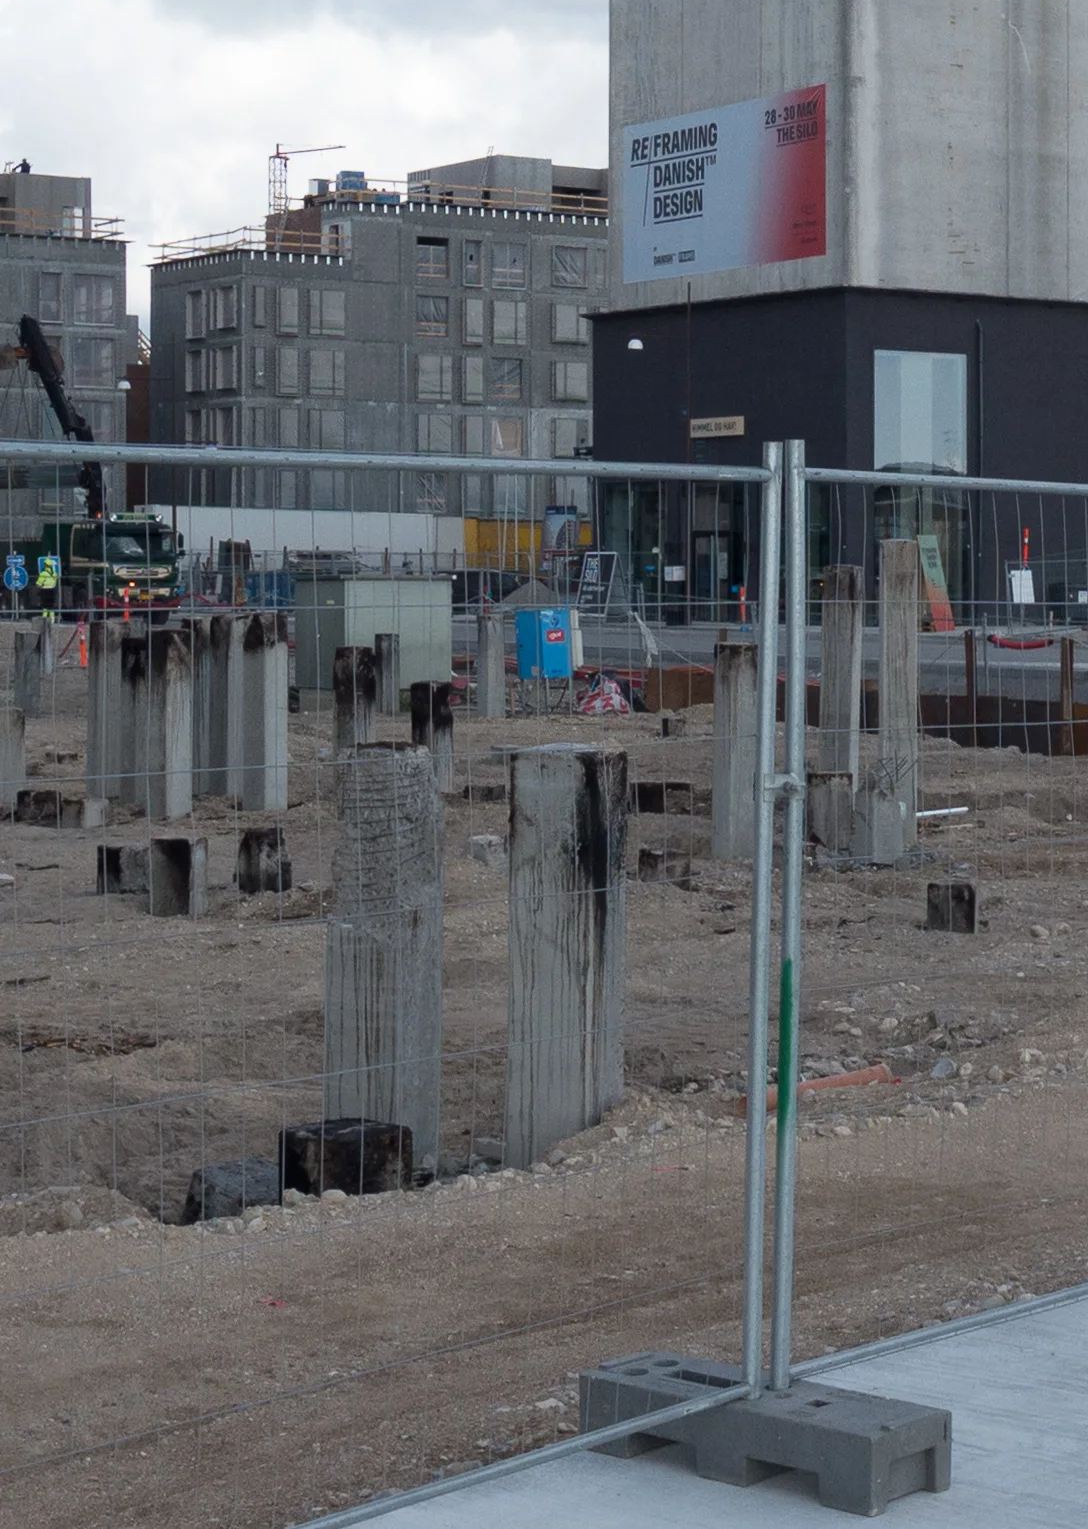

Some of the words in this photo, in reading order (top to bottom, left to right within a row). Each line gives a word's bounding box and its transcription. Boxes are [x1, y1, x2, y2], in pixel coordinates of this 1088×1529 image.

[764, 108, 777, 125] 28
[783, 105, 796, 122] 30
[776, 125, 796, 144] THE
[796, 120, 818, 140] SILO
[653, 188, 703, 220] DESIGN
